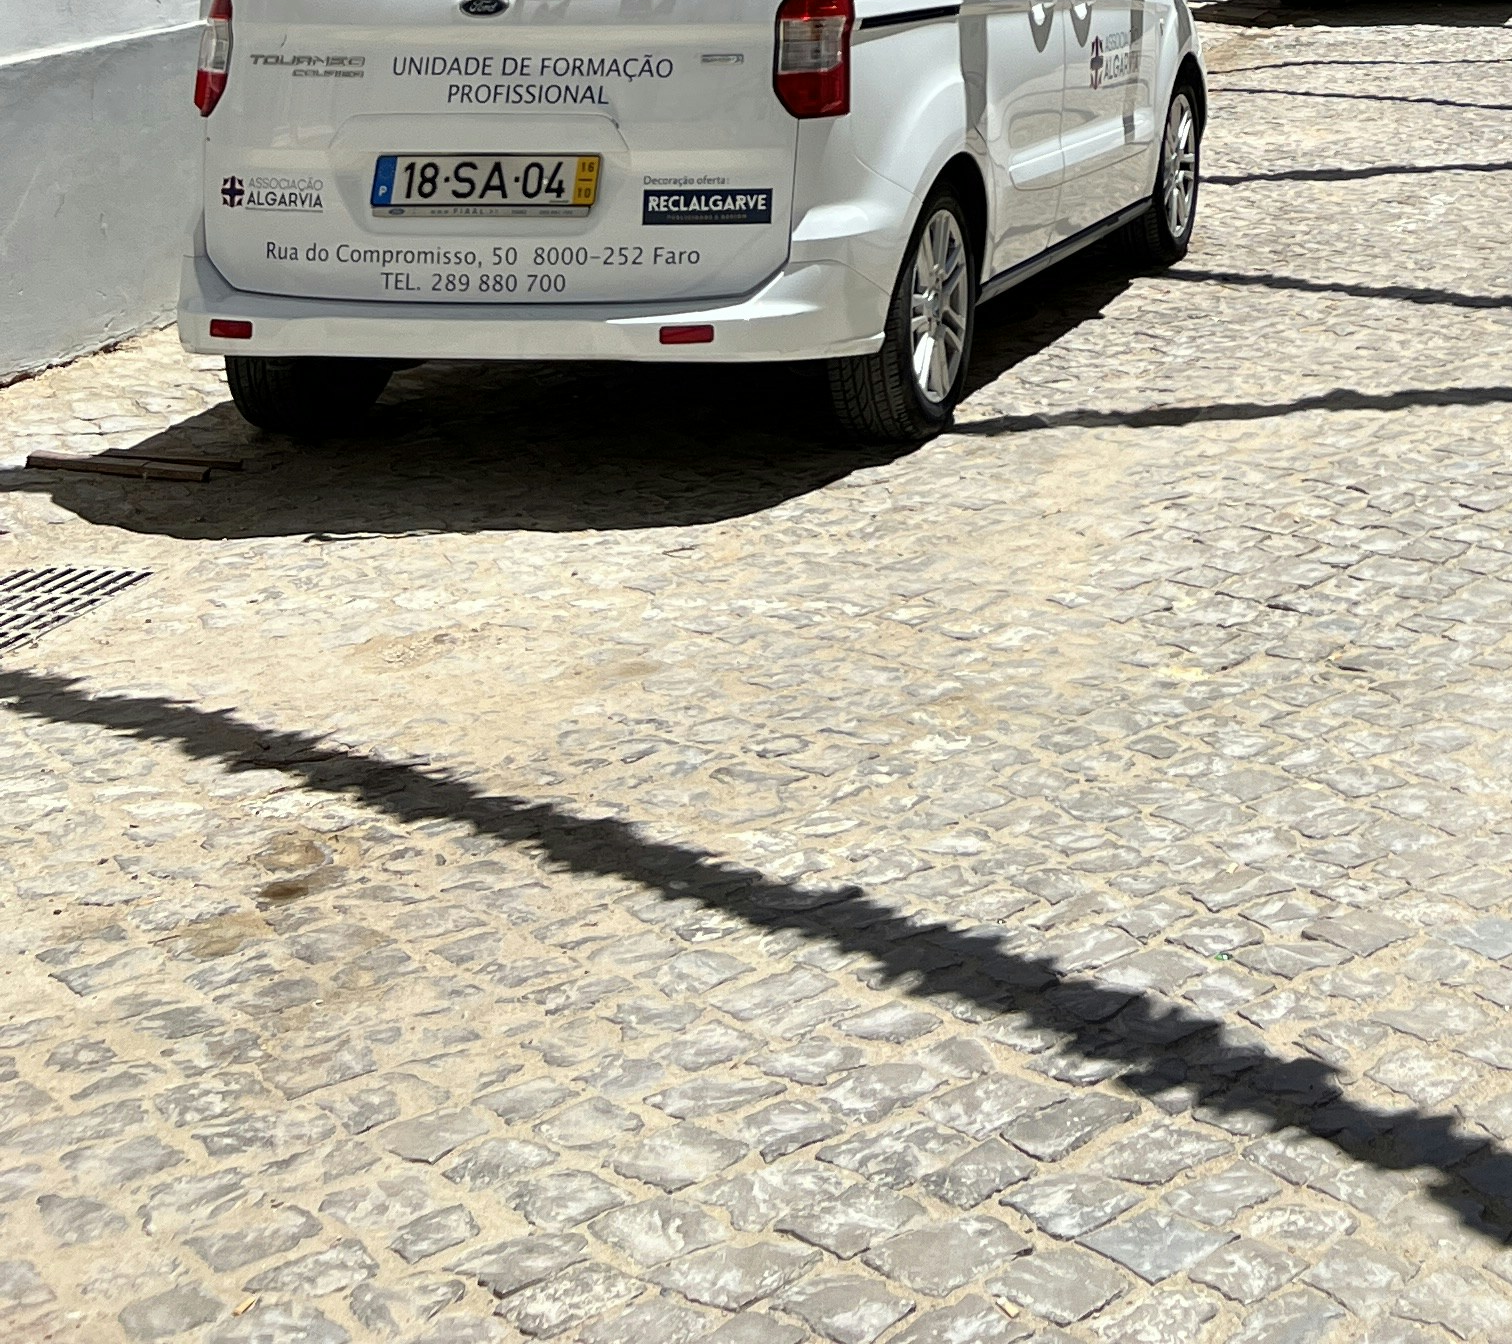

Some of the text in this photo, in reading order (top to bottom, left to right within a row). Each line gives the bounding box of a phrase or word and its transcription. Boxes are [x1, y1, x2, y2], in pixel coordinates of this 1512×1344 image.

[392, 54, 674, 83] UNIDADE DE FORMAÇÃO
[447, 83, 610, 105] PROFISSIONAL
[580, 162, 595, 173] 16
[248, 176, 324, 192] ASSOCIAÇÃO
[643, 175, 695, 187] Decoração
[246, 190, 323, 208] ALGARVIA
[378, 185, 388, 197] P
[577, 187, 592, 199] 10
[647, 194, 767, 212] RECLALGARVE
[265, 241, 700, 268] Rua do Compromisso, 50 8000-252 Faro
[381, 271, 566, 293] TEL. 289 880 700
